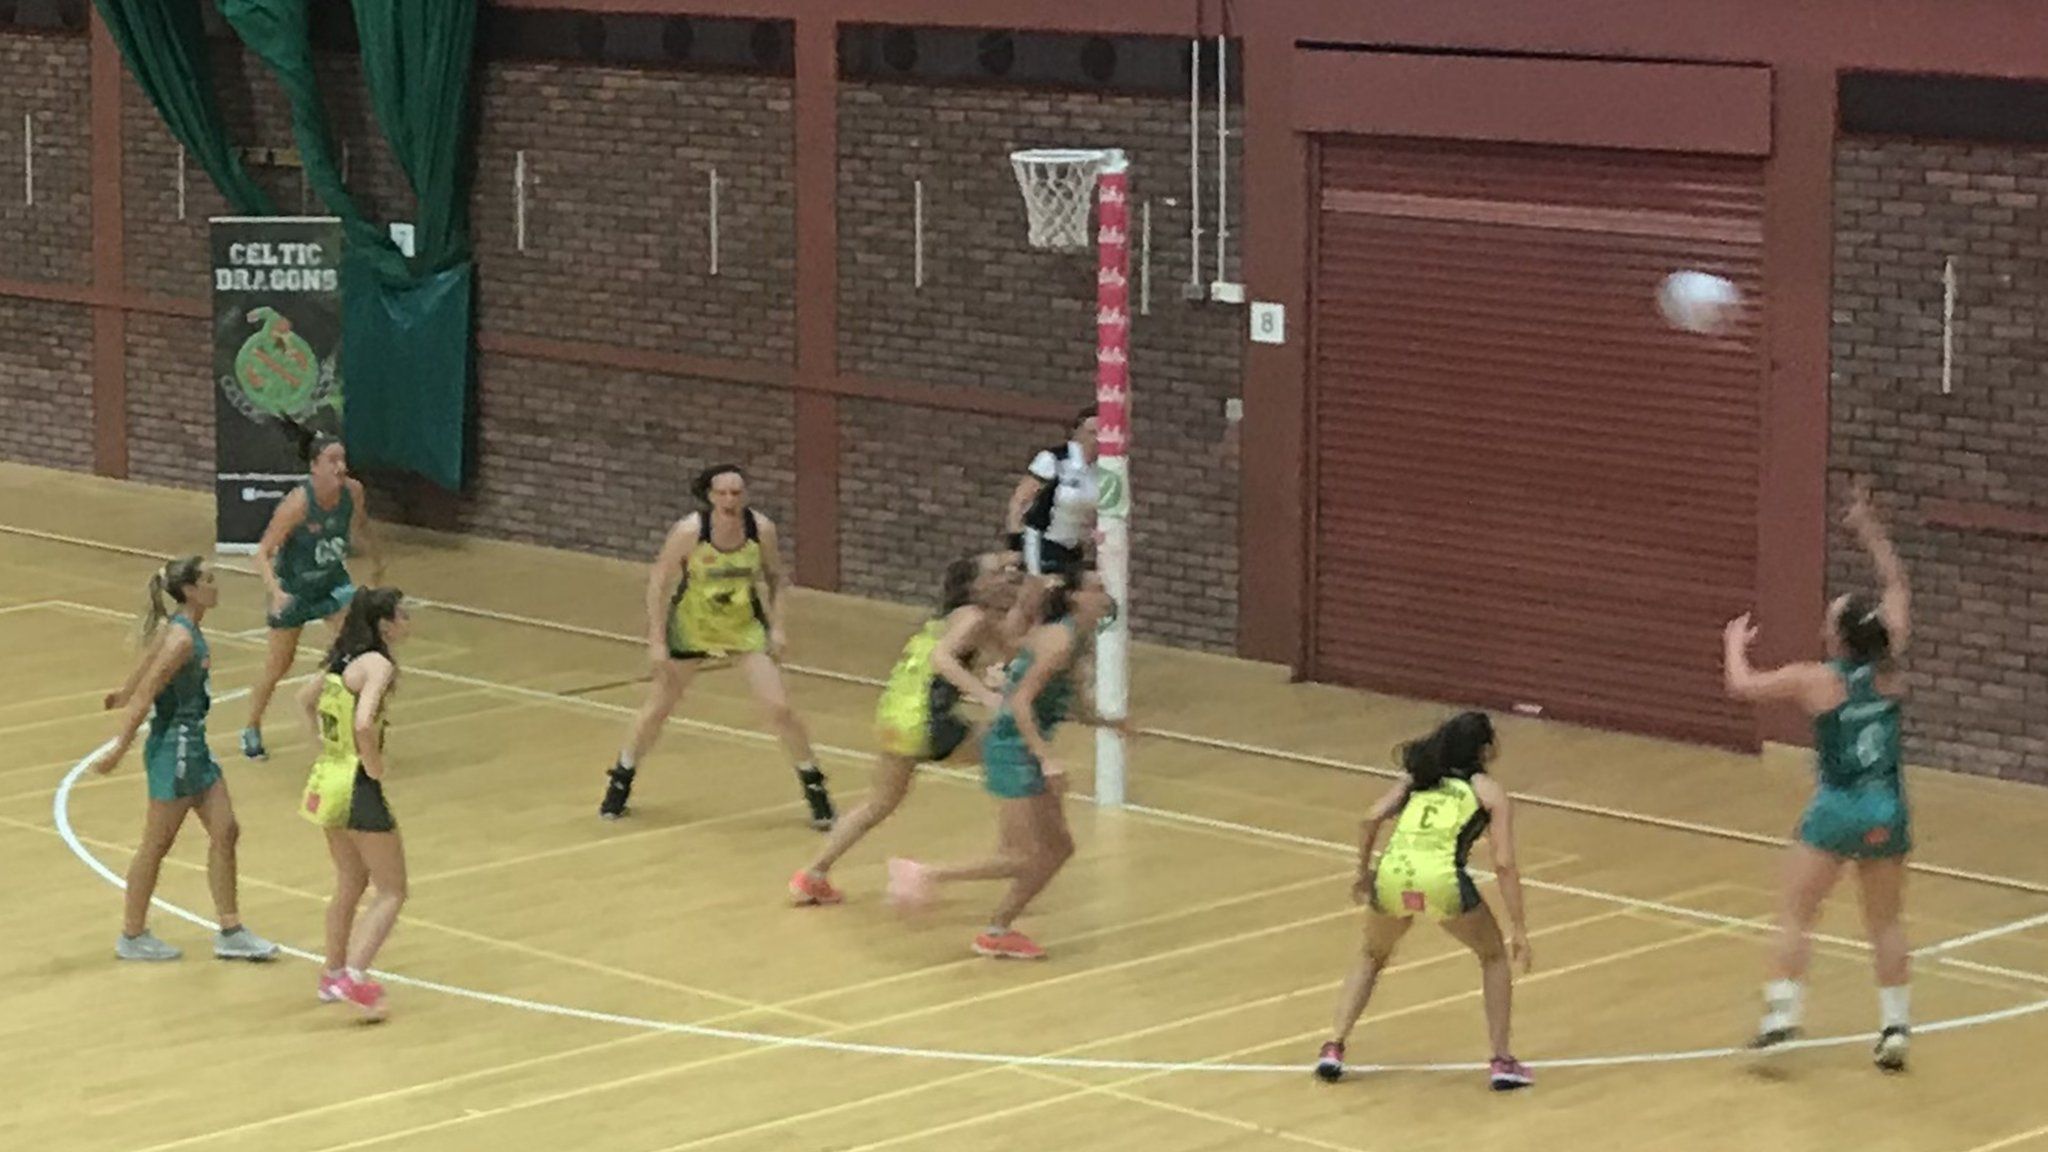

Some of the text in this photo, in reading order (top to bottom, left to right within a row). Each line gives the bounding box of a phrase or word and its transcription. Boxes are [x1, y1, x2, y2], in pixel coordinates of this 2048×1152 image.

[229, 242, 322, 266] CELTIC
[215, 267, 338, 291] DRAGONS
[1261, 311, 1274, 333] 8
